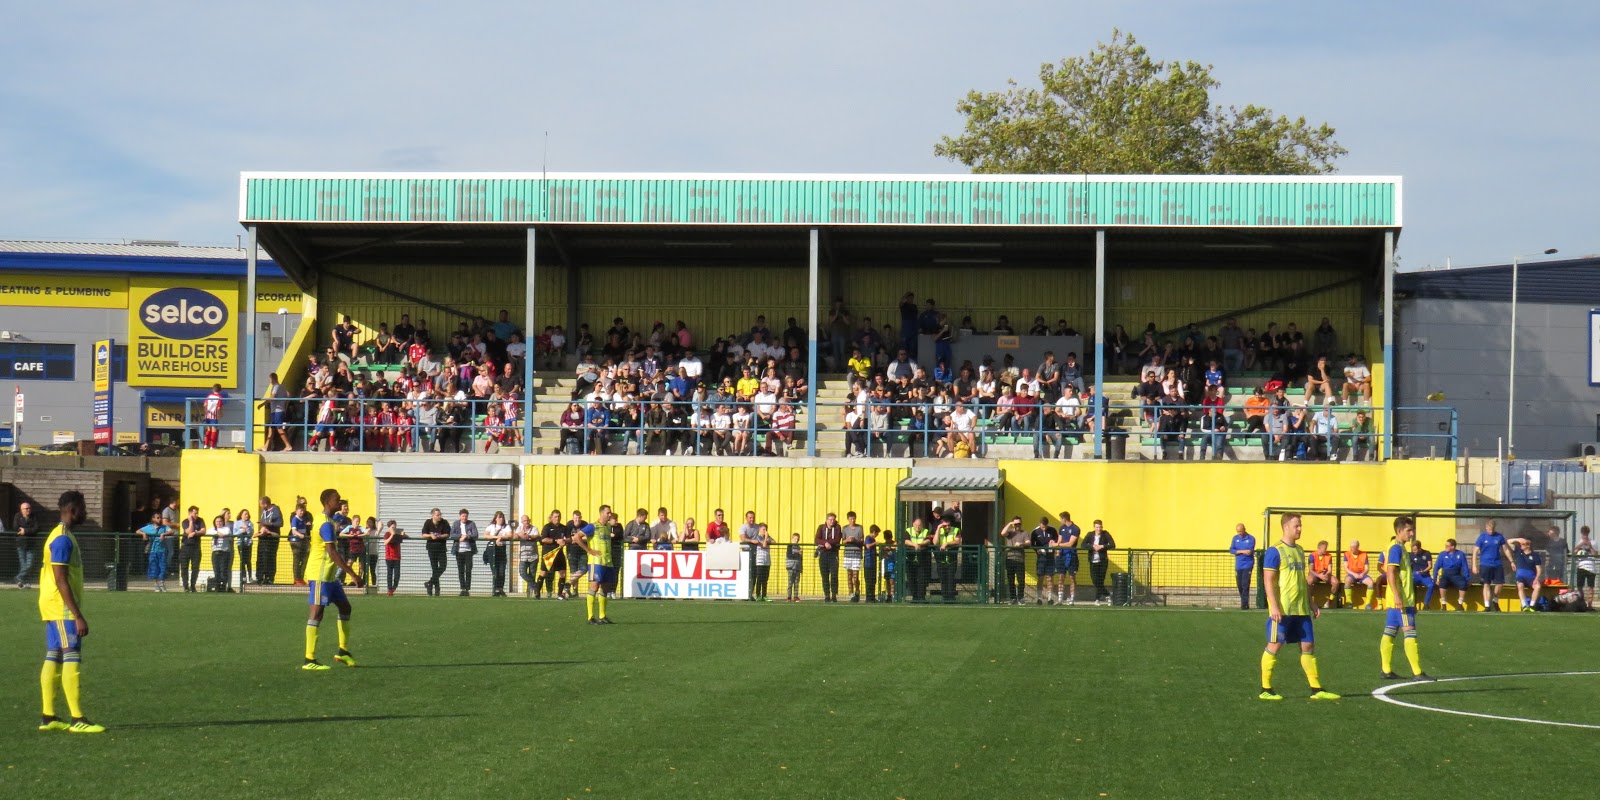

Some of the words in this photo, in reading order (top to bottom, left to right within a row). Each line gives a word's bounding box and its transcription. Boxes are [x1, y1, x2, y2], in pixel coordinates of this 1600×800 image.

[0, 285, 41, 295] EATING
[44, 286, 52, 295] &
[55, 287, 112, 297] PLUMBING
[256, 292, 303, 302] ECORATI
[145, 298, 223, 325] selco
[137, 342, 228, 359] BUILDERS
[14, 362, 44, 371] CAFE
[137, 360, 228, 372] WAREHOUSE
[636, 582, 679, 597] VAN
[687, 583, 737, 597] HIRE
